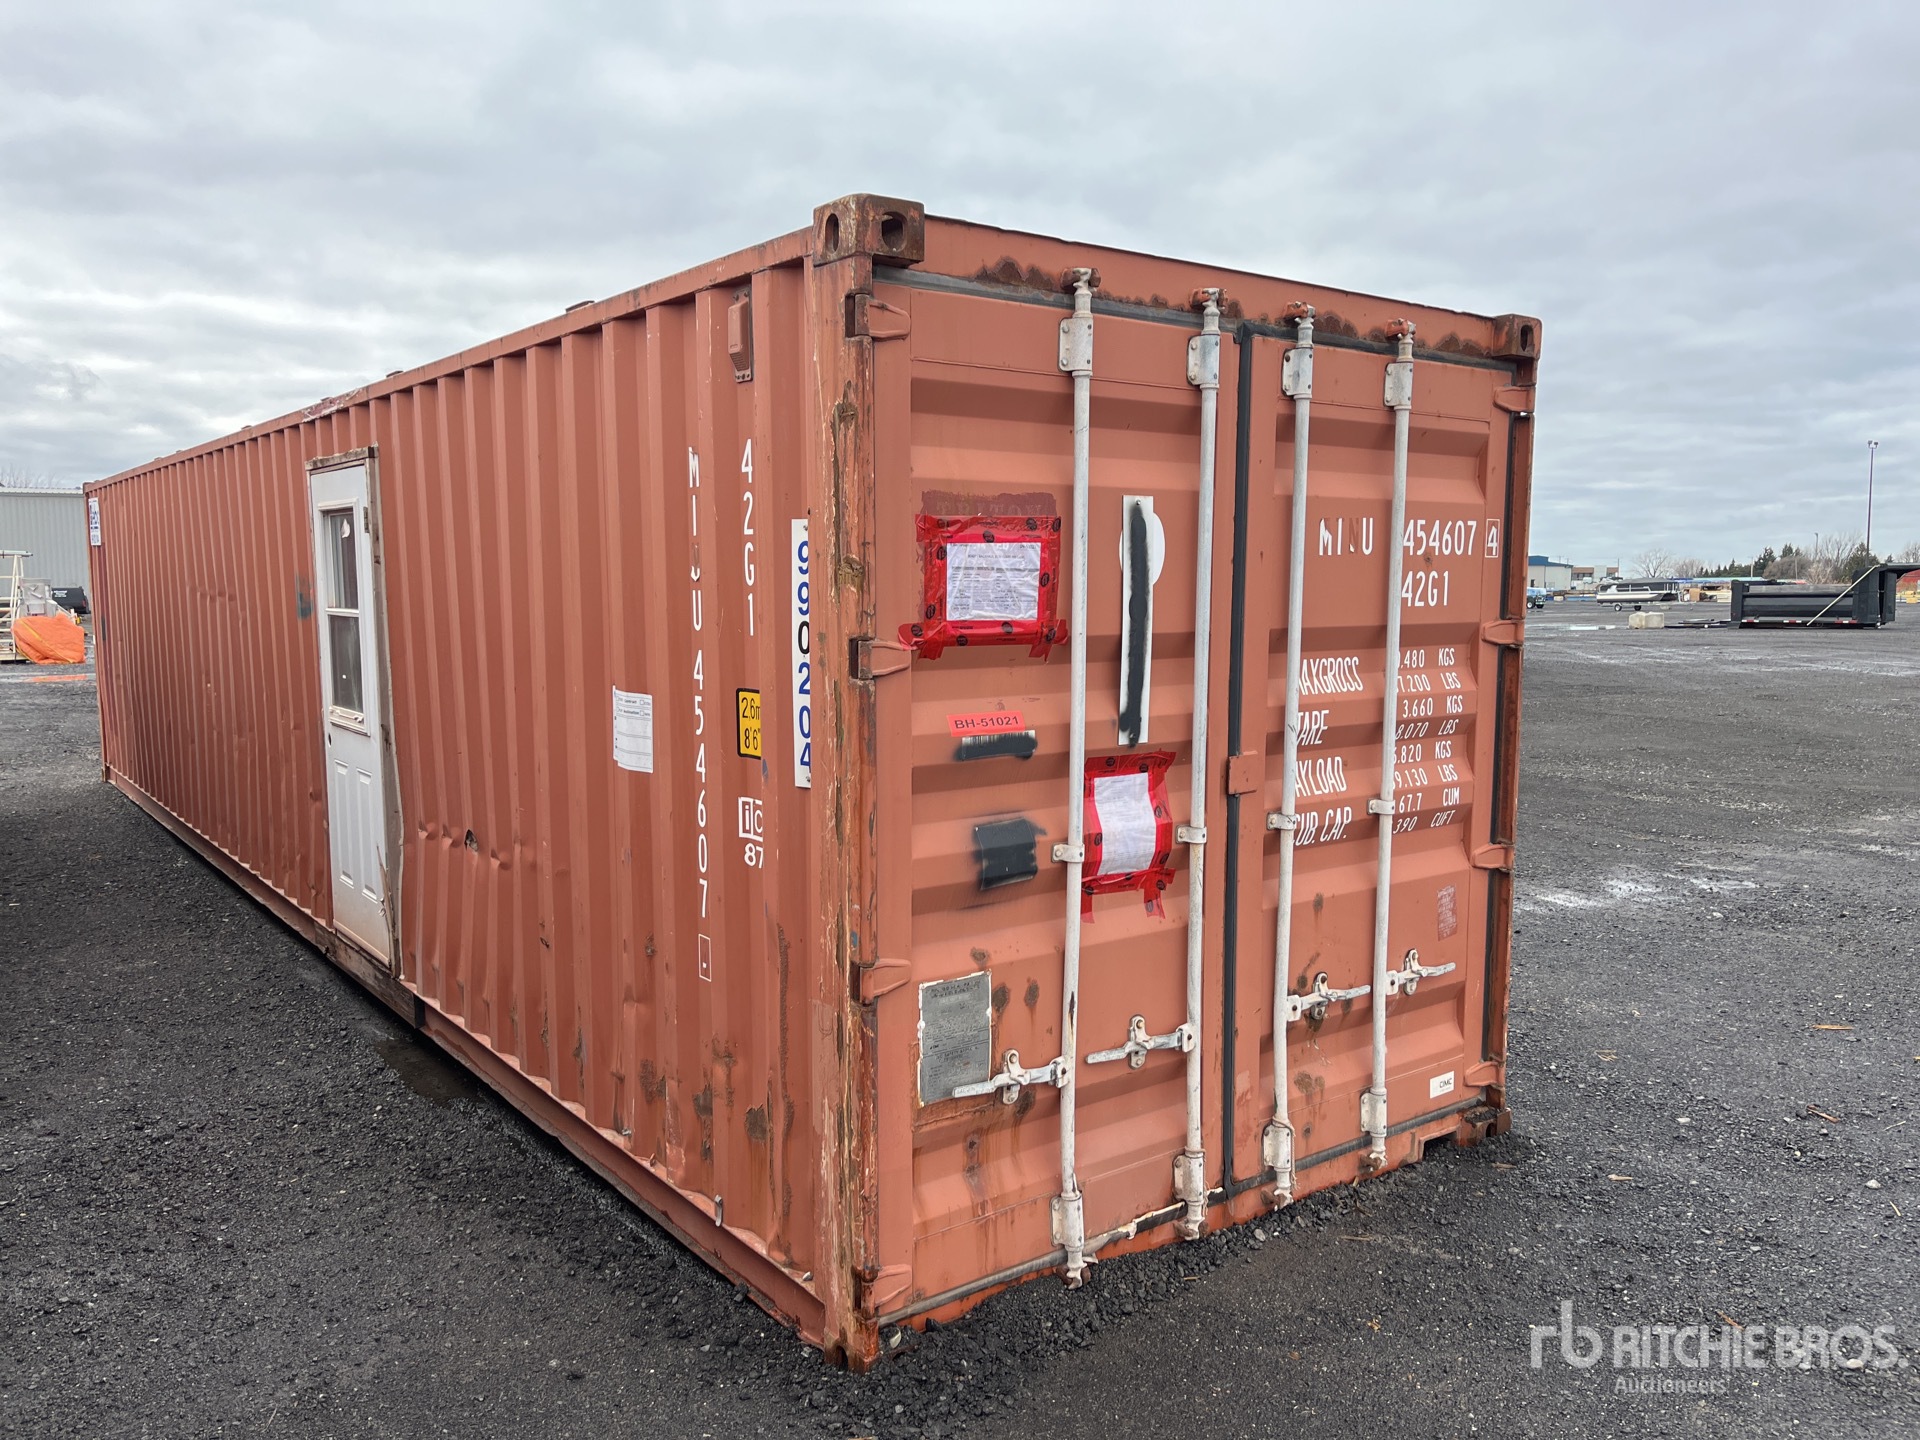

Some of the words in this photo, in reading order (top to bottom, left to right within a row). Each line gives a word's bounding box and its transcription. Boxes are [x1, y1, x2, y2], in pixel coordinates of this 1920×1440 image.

[741, 438, 755, 636] 42G1
[1403, 519, 1477, 556] 454607
[1402, 570, 1449, 607] 42G1
[1438, 648, 1455, 667] KGS
[1299, 656, 1364, 696] AXGROSS
[1397, 673, 1431, 693] 7.200
[1440, 671, 1461, 690] LBS
[1446, 694, 1463, 714] KGS
[954, 715, 1019, 729] BH-51021
[1437, 718, 1459, 736] LBS
[1394, 743, 1422, 764] 6.820
[1435, 740, 1452, 760] KGS
[1295, 756, 1347, 798] AYLOAD
[1393, 767, 1428, 790] 9.130
[1437, 763, 1458, 783] LBS
[1442, 786, 1460, 807] CUM
[744, 843, 763, 868] 87
